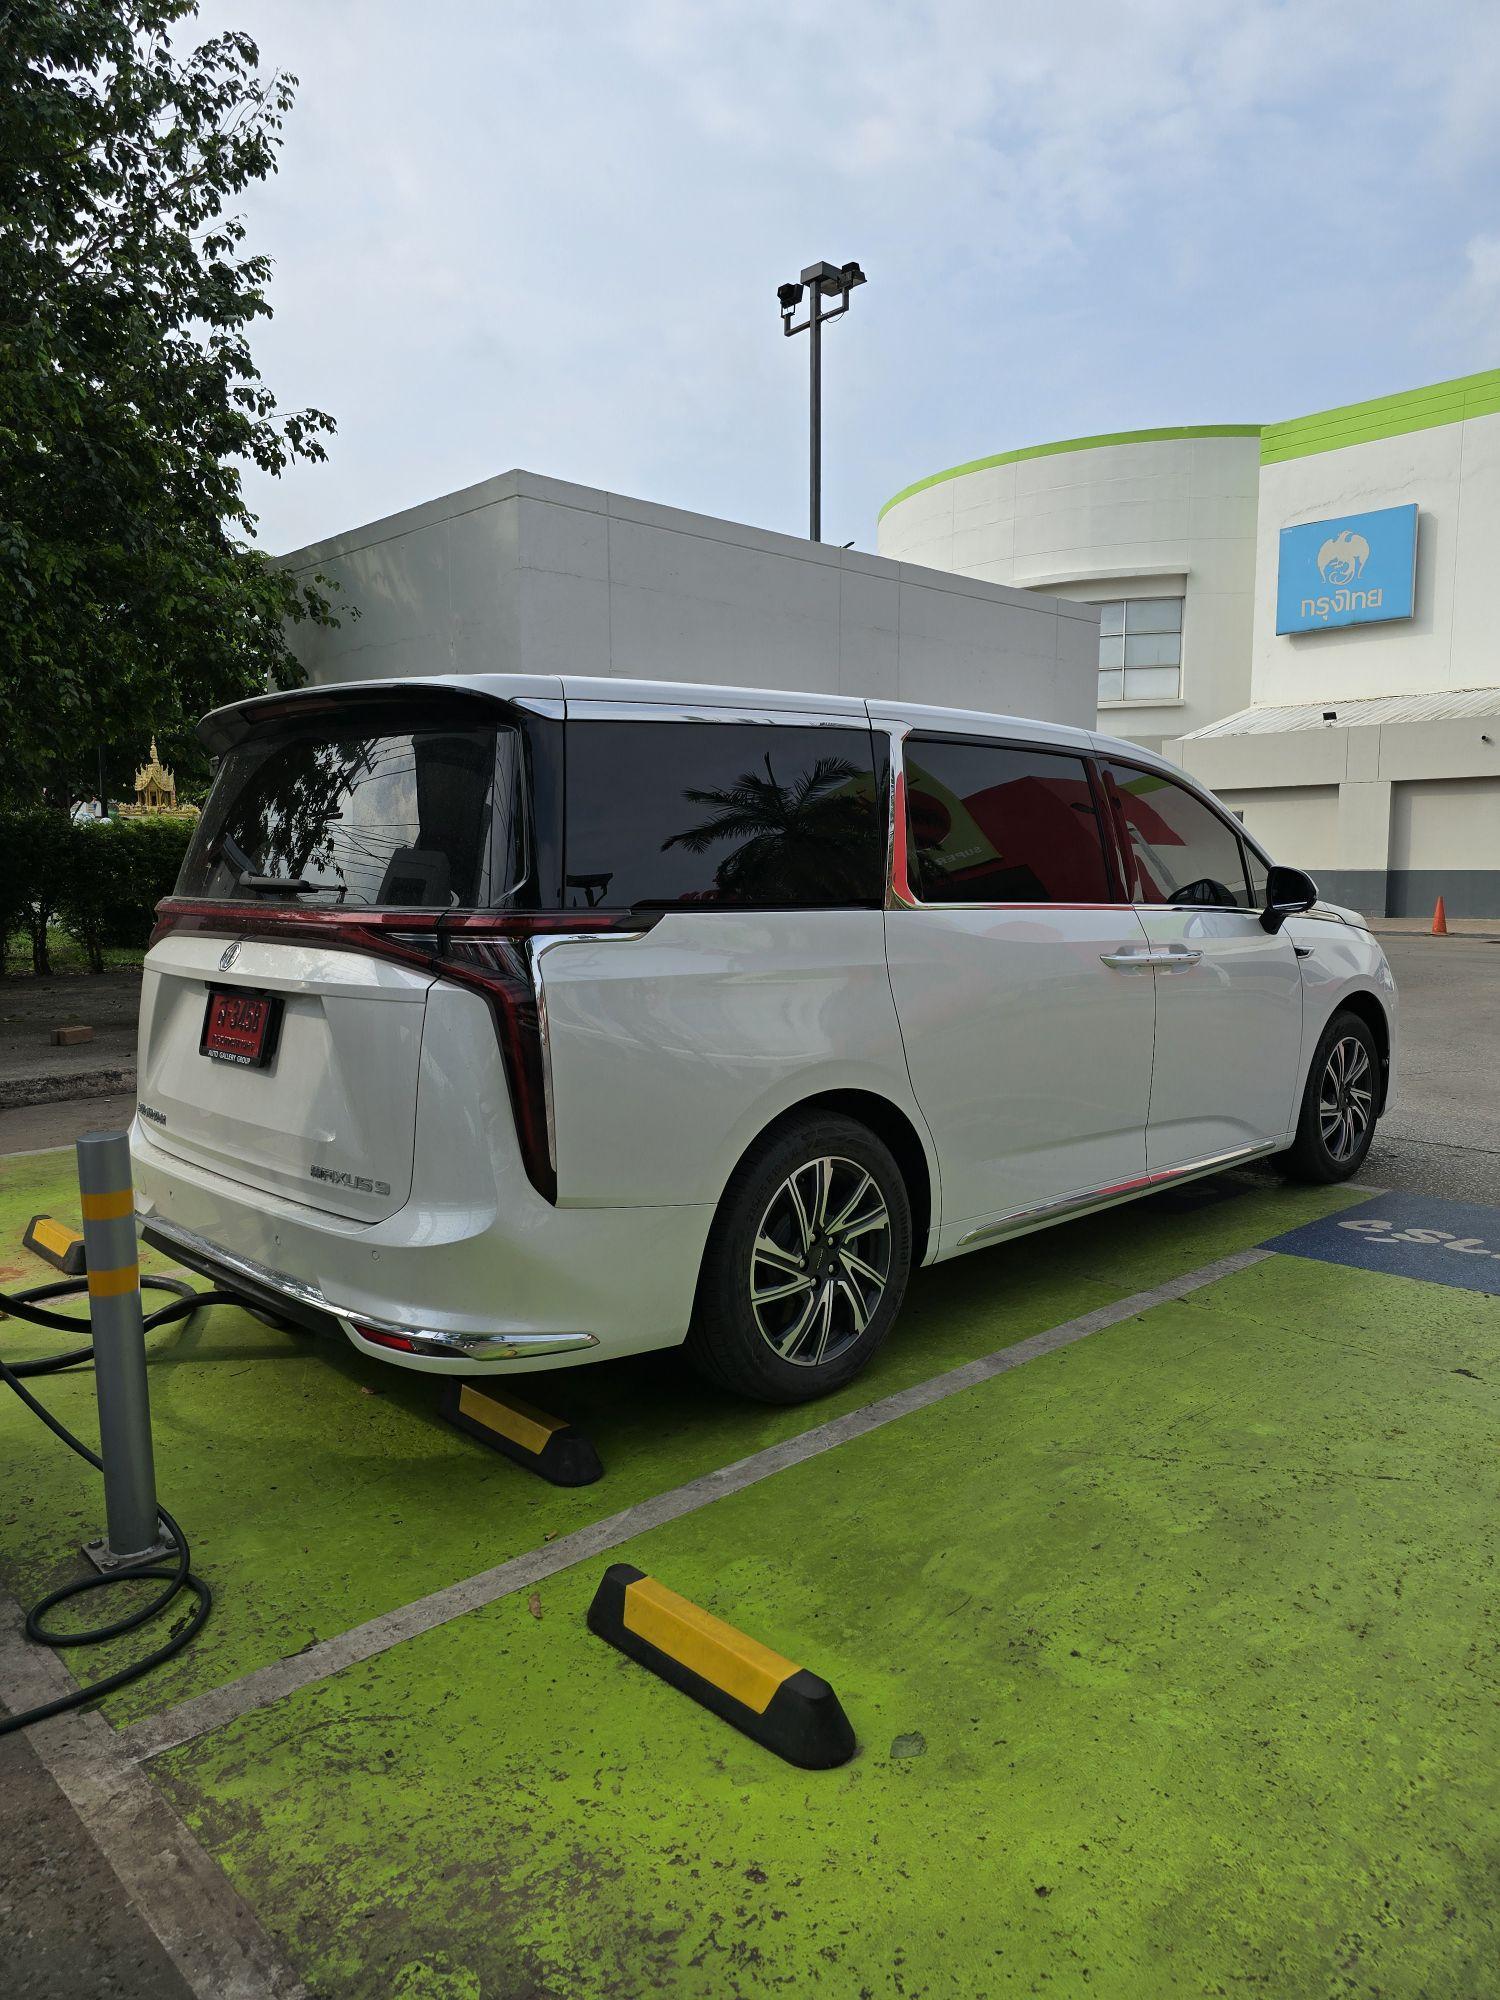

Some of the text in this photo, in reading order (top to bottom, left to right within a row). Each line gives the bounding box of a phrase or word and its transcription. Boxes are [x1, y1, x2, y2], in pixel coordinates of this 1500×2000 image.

[1301, 588, 1383, 621] กรุงไทย
[208, 1049, 251, 1065] AUTO GALLERY GROUP
[1337, 1219, 1500, 1259] าร์จ
